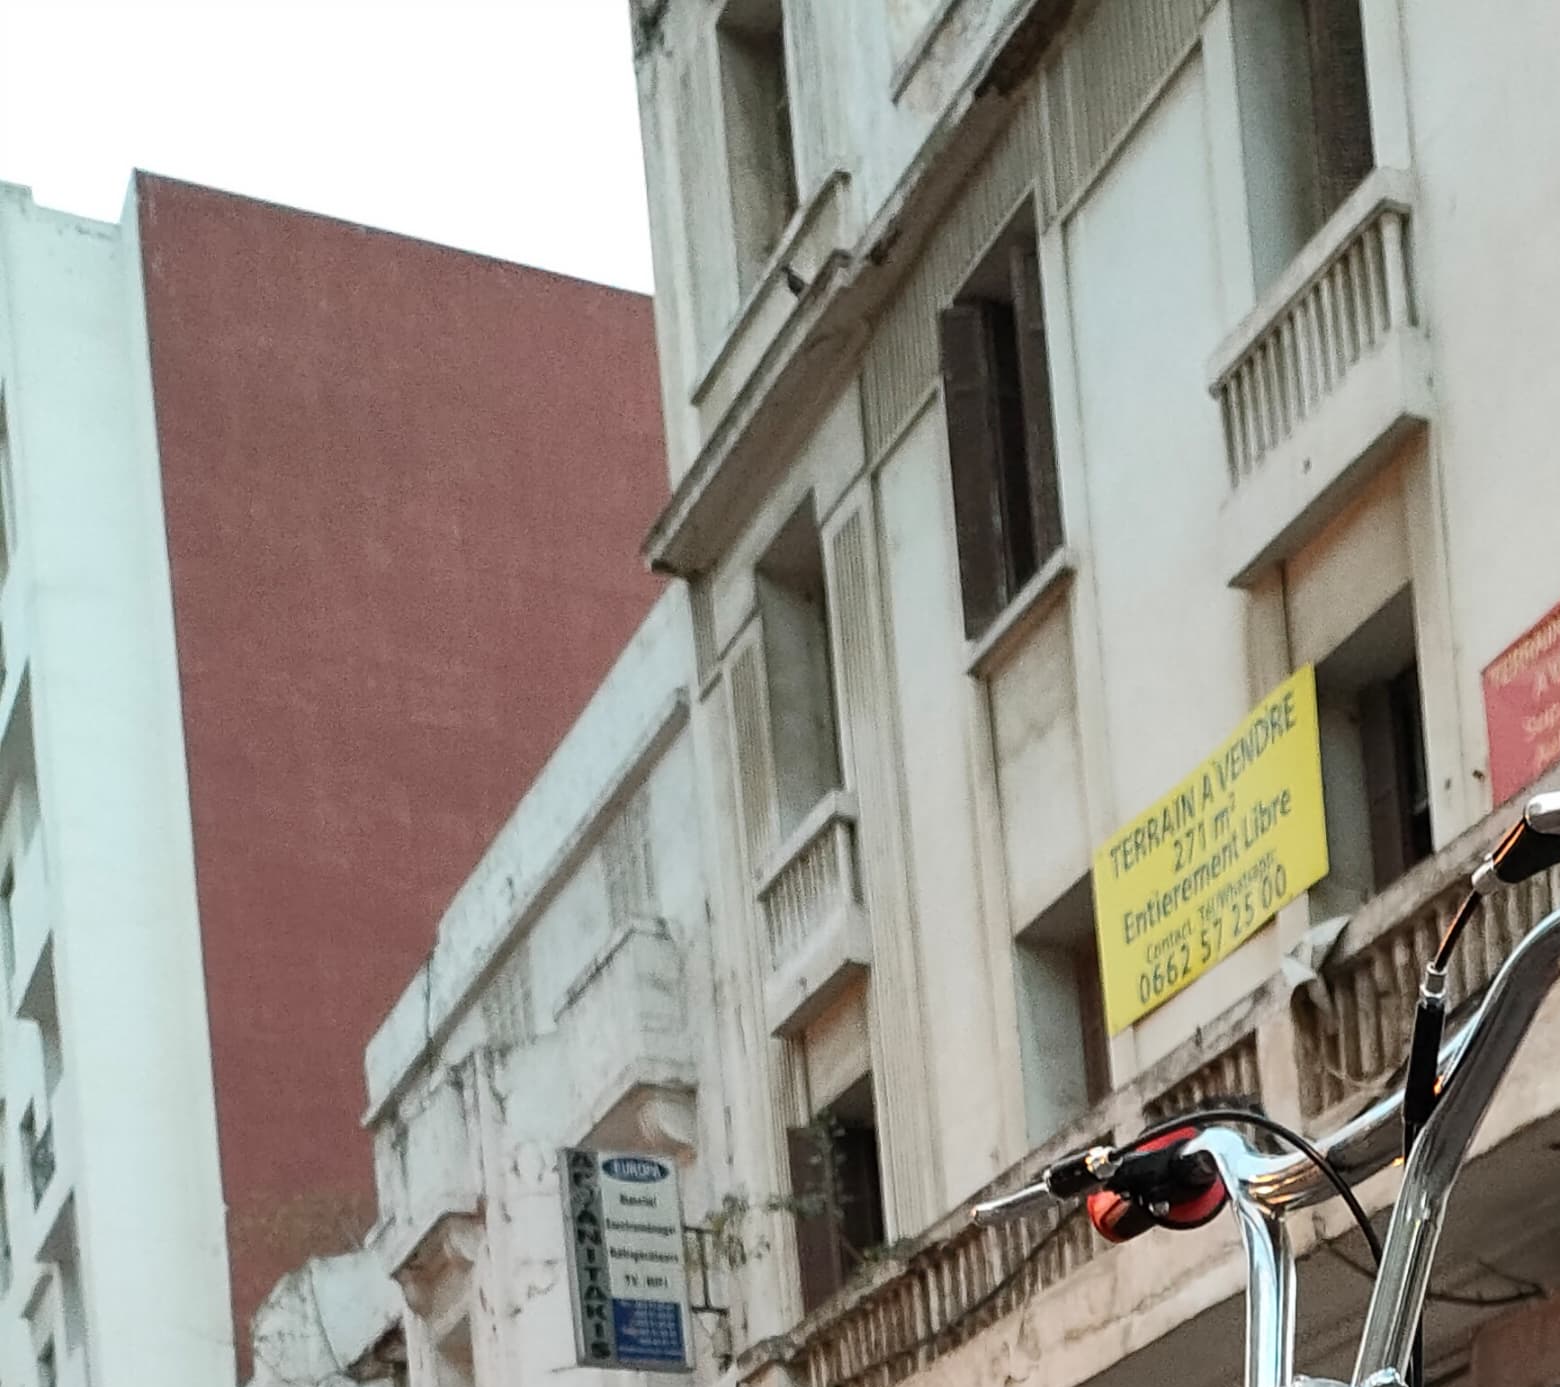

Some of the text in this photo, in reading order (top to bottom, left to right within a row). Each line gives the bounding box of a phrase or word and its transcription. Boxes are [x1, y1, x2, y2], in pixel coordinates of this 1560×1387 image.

[1110, 690, 1298, 879] TERRAIN A VENDRE
[1173, 792, 1237, 873] 271 m²
[1244, 788, 1292, 851] Libre
[1138, 864, 1288, 1006] 0662 57 25 00
